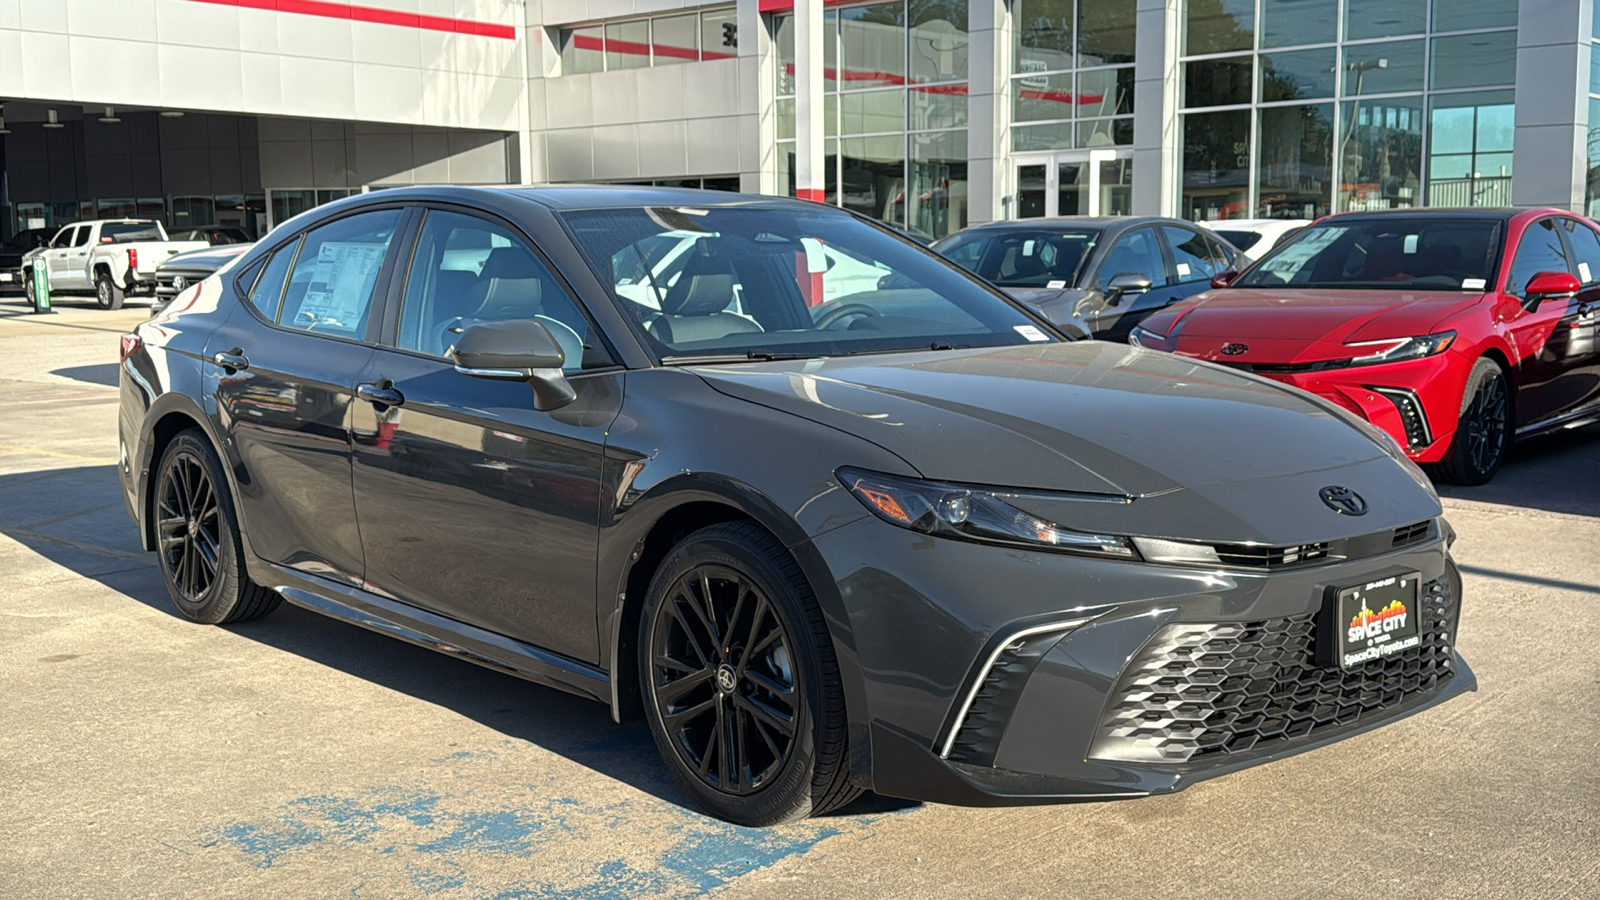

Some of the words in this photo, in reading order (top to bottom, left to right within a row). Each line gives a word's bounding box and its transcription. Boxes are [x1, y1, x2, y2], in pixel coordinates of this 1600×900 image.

[1236, 155, 1249, 168] CIT
[1348, 619, 1382, 643] SPACE
[1383, 612, 1407, 633] CITY
[1344, 636, 1419, 666] SpaceCityToyota.com
